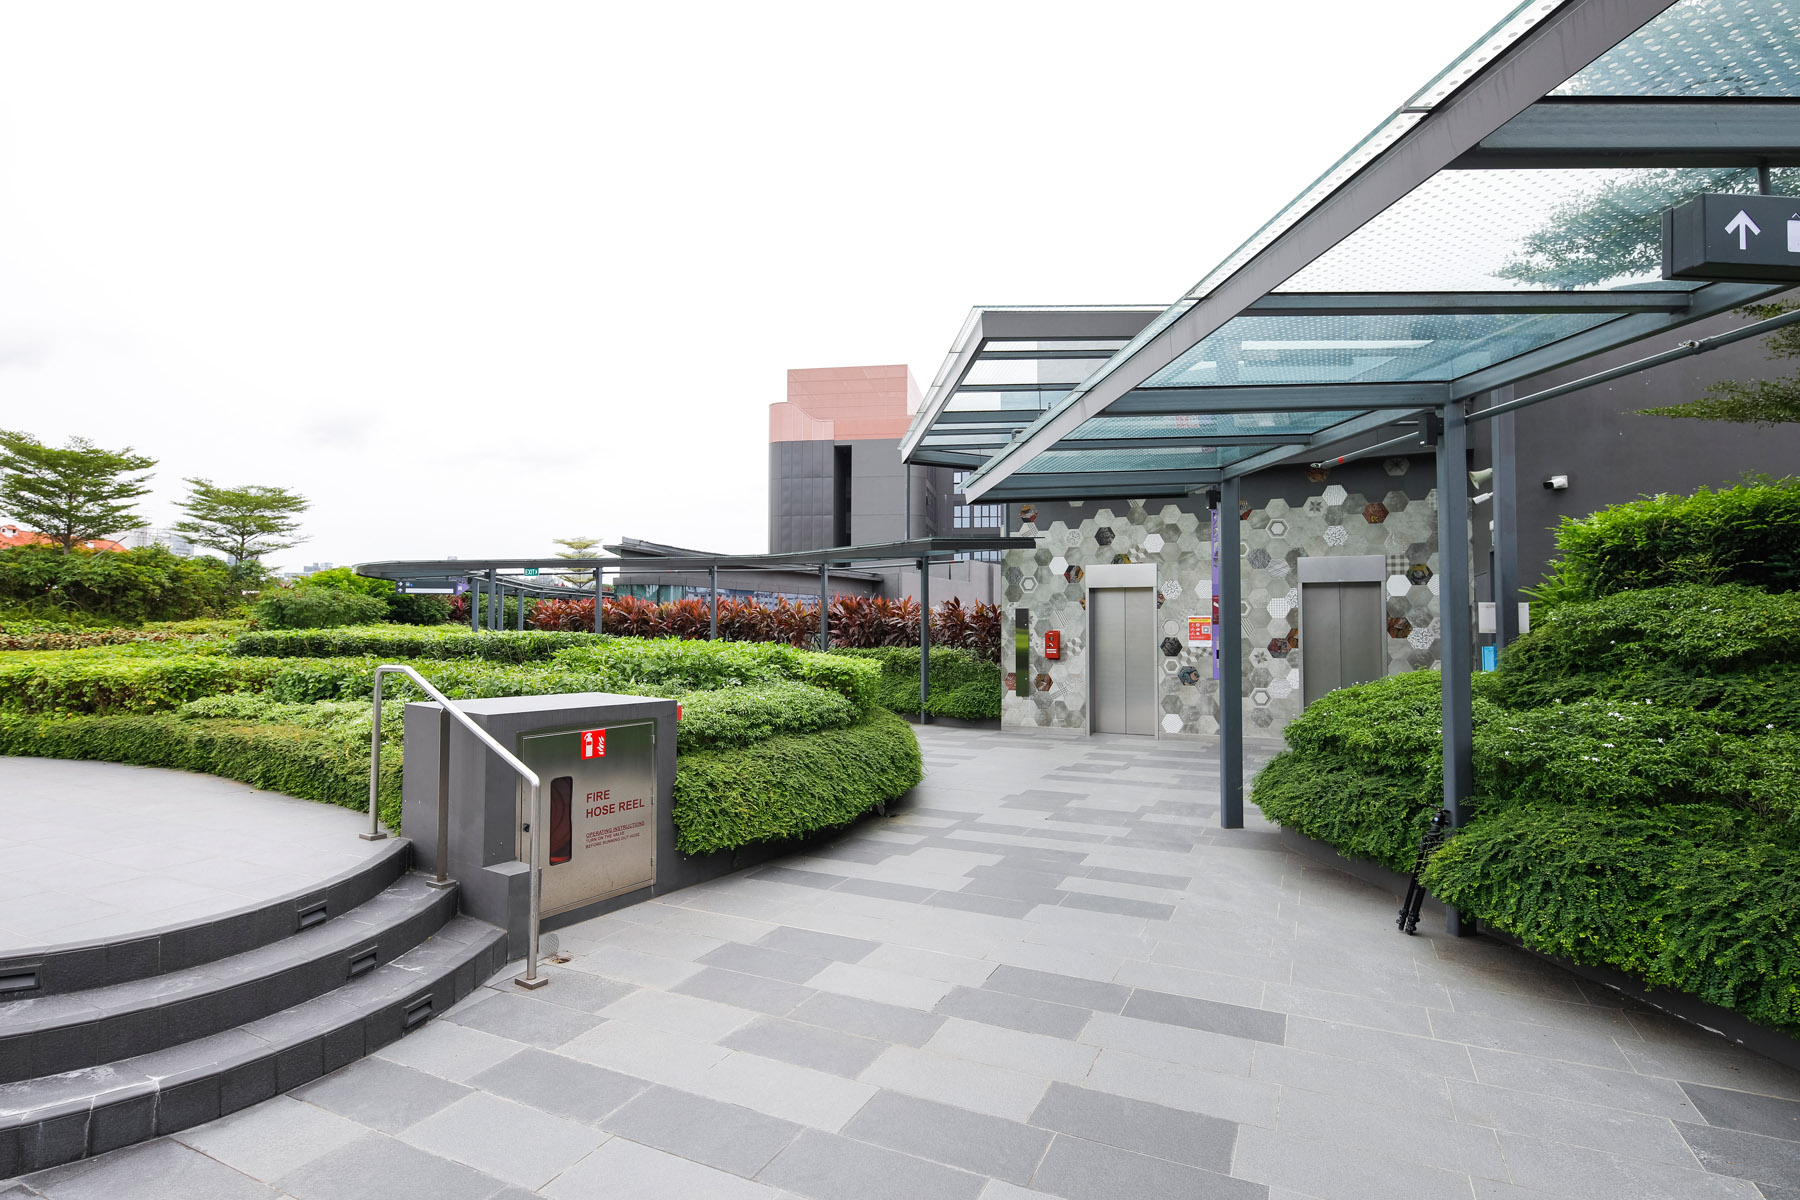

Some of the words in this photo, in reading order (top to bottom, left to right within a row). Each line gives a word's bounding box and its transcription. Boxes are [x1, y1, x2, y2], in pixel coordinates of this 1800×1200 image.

[586, 789, 610, 803] FIRE
[586, 803, 616, 818] HOSE
[618, 798, 645, 812] REEL
[586, 828, 612, 838] OPERATING
[613, 821, 645, 832] INSTRUCTIONS
